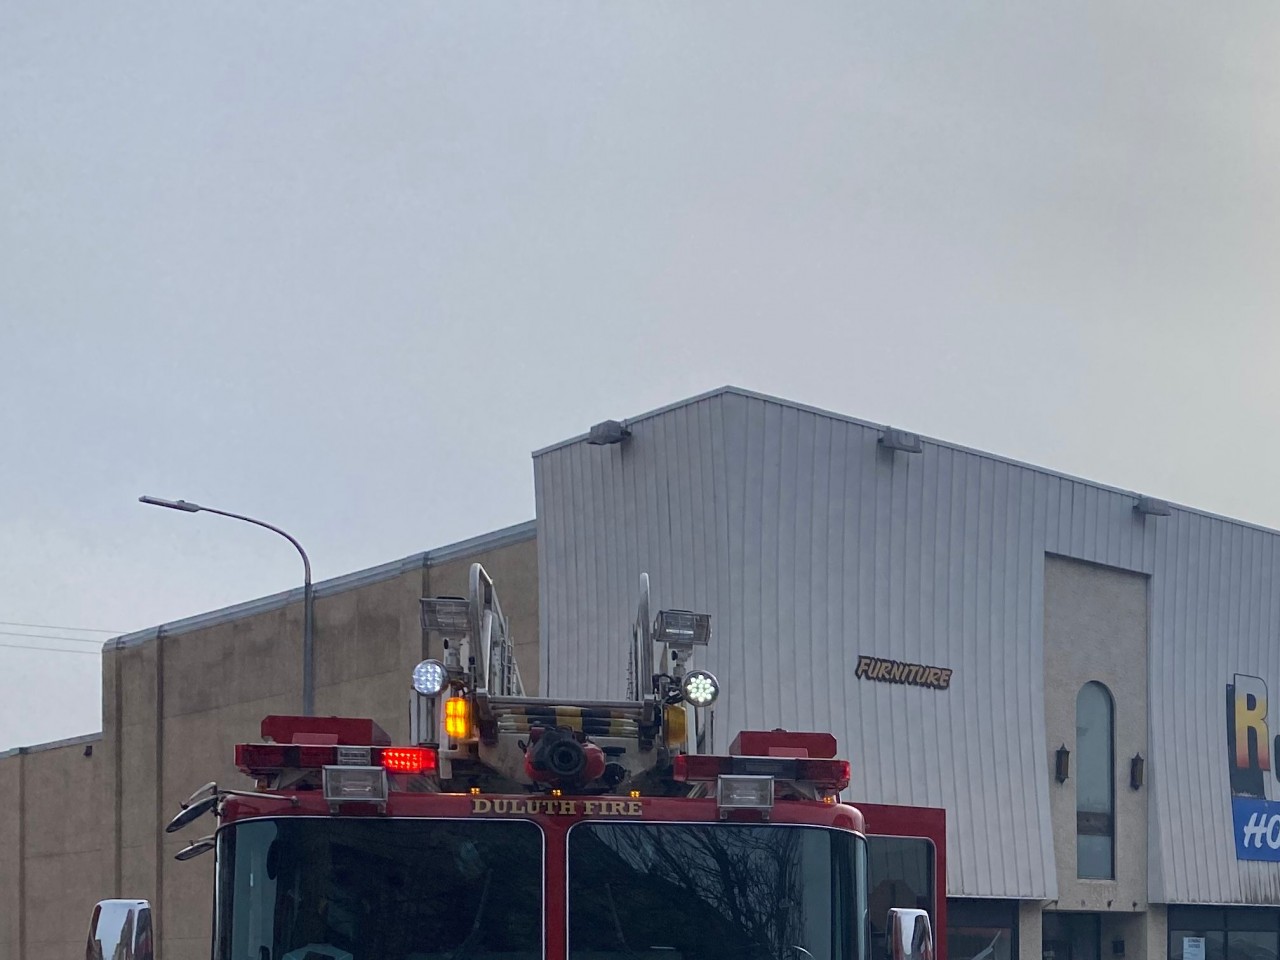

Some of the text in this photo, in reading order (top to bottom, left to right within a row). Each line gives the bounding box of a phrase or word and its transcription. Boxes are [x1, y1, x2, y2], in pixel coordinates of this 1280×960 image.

[856, 656, 952, 689] FURNITURE
[472, 798, 643, 816] DULUTH FIRE
